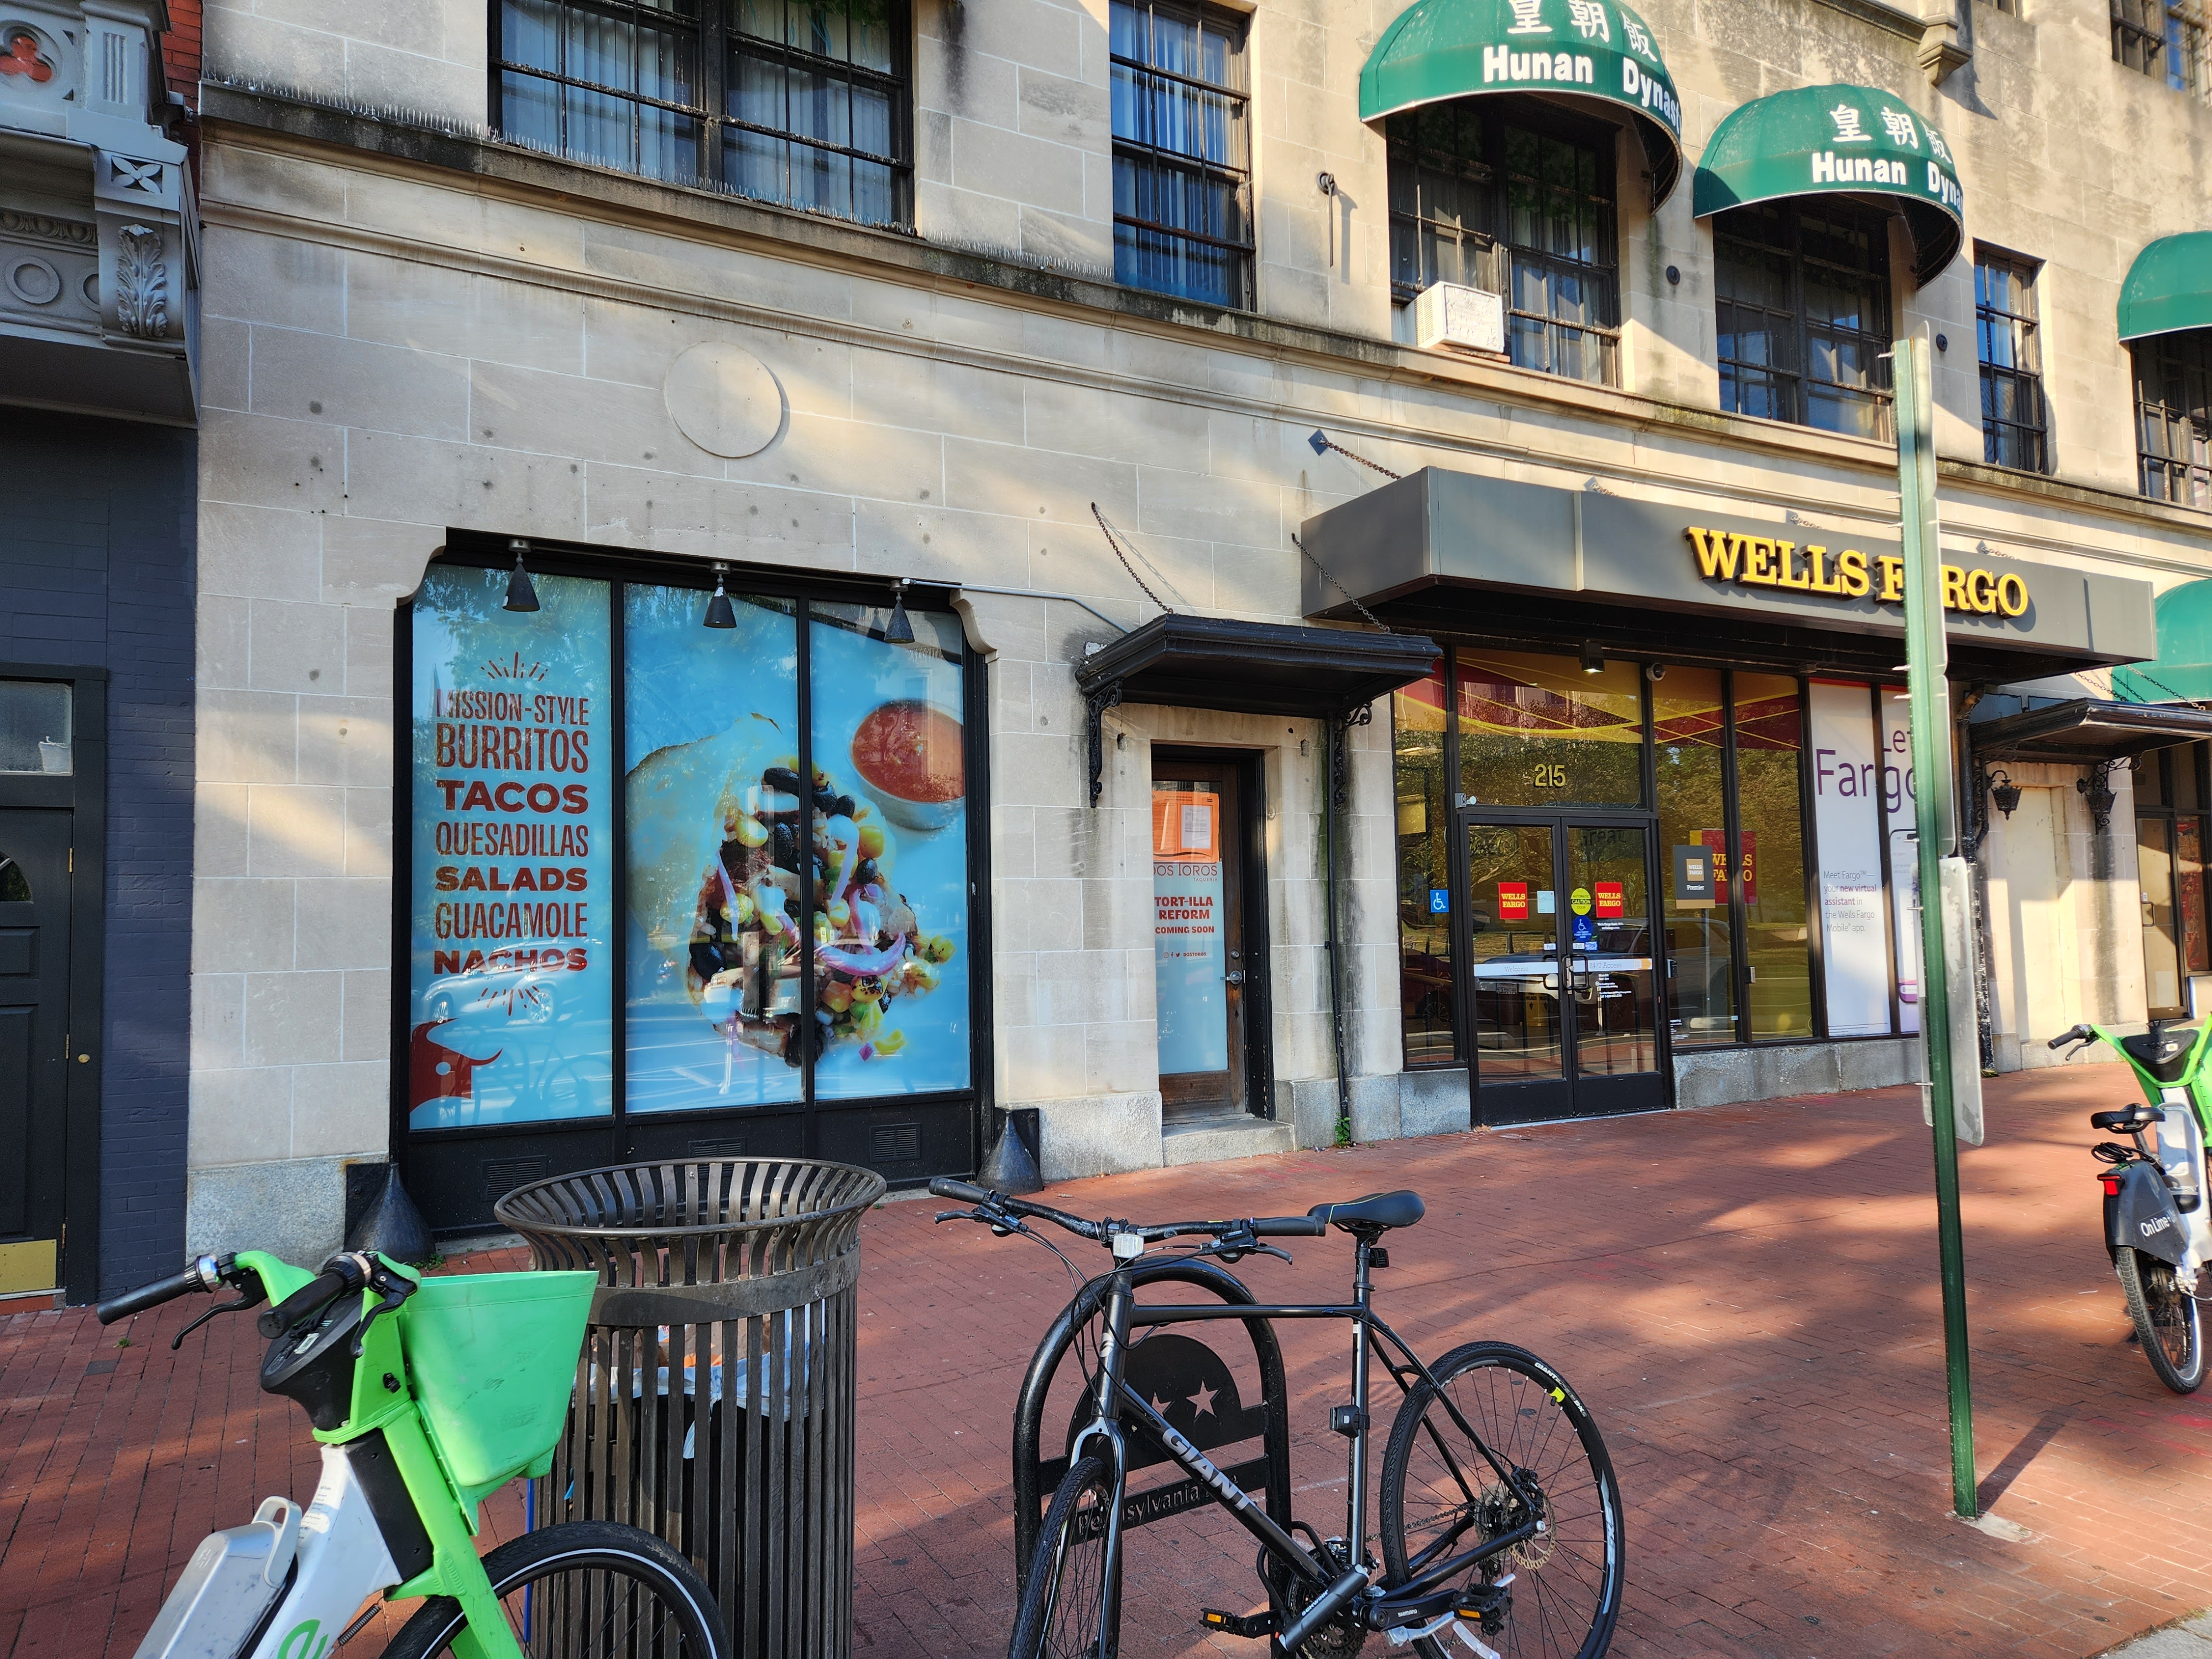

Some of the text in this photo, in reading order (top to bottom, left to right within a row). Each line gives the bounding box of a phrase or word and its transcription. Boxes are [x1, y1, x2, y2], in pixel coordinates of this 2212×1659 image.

[1483, 45, 1682, 141] Hunan Dynast
[1812, 150, 1907, 186] Hunan
[1683, 526, 2028, 618] WELLS FRGO
[436, 722, 589, 774] BURRITOS
[1533, 764, 1566, 787] 215
[436, 780, 589, 815] TACOS
[435, 821, 588, 857] QUESADILLAS
[1178, 863, 1218, 876] TOROS
[1712, 853, 1752, 867] WES
[435, 866, 588, 891] SALADS
[1713, 869, 1752, 881] FAO
[1823, 870, 1841, 879] Meet
[1824, 885, 1839, 894] your
[1855, 884, 1877, 892] virtual
[1825, 896, 1863, 905] assistant in
[1154, 896, 1214, 907] TORT-ILLA
[435, 902, 588, 939] GUACAMOLE
[1159, 909, 1210, 920] REFORM
[1825, 910, 1875, 920] the Wells Fargo
[1852, 925, 1866, 933] app.
[434, 948, 588, 975] NACHOS
[1535, 1361, 1558, 1380] GIANT
[1162, 1427, 1258, 1510] GIANT
[1078, 1484, 1199, 1536] Pesylvania
